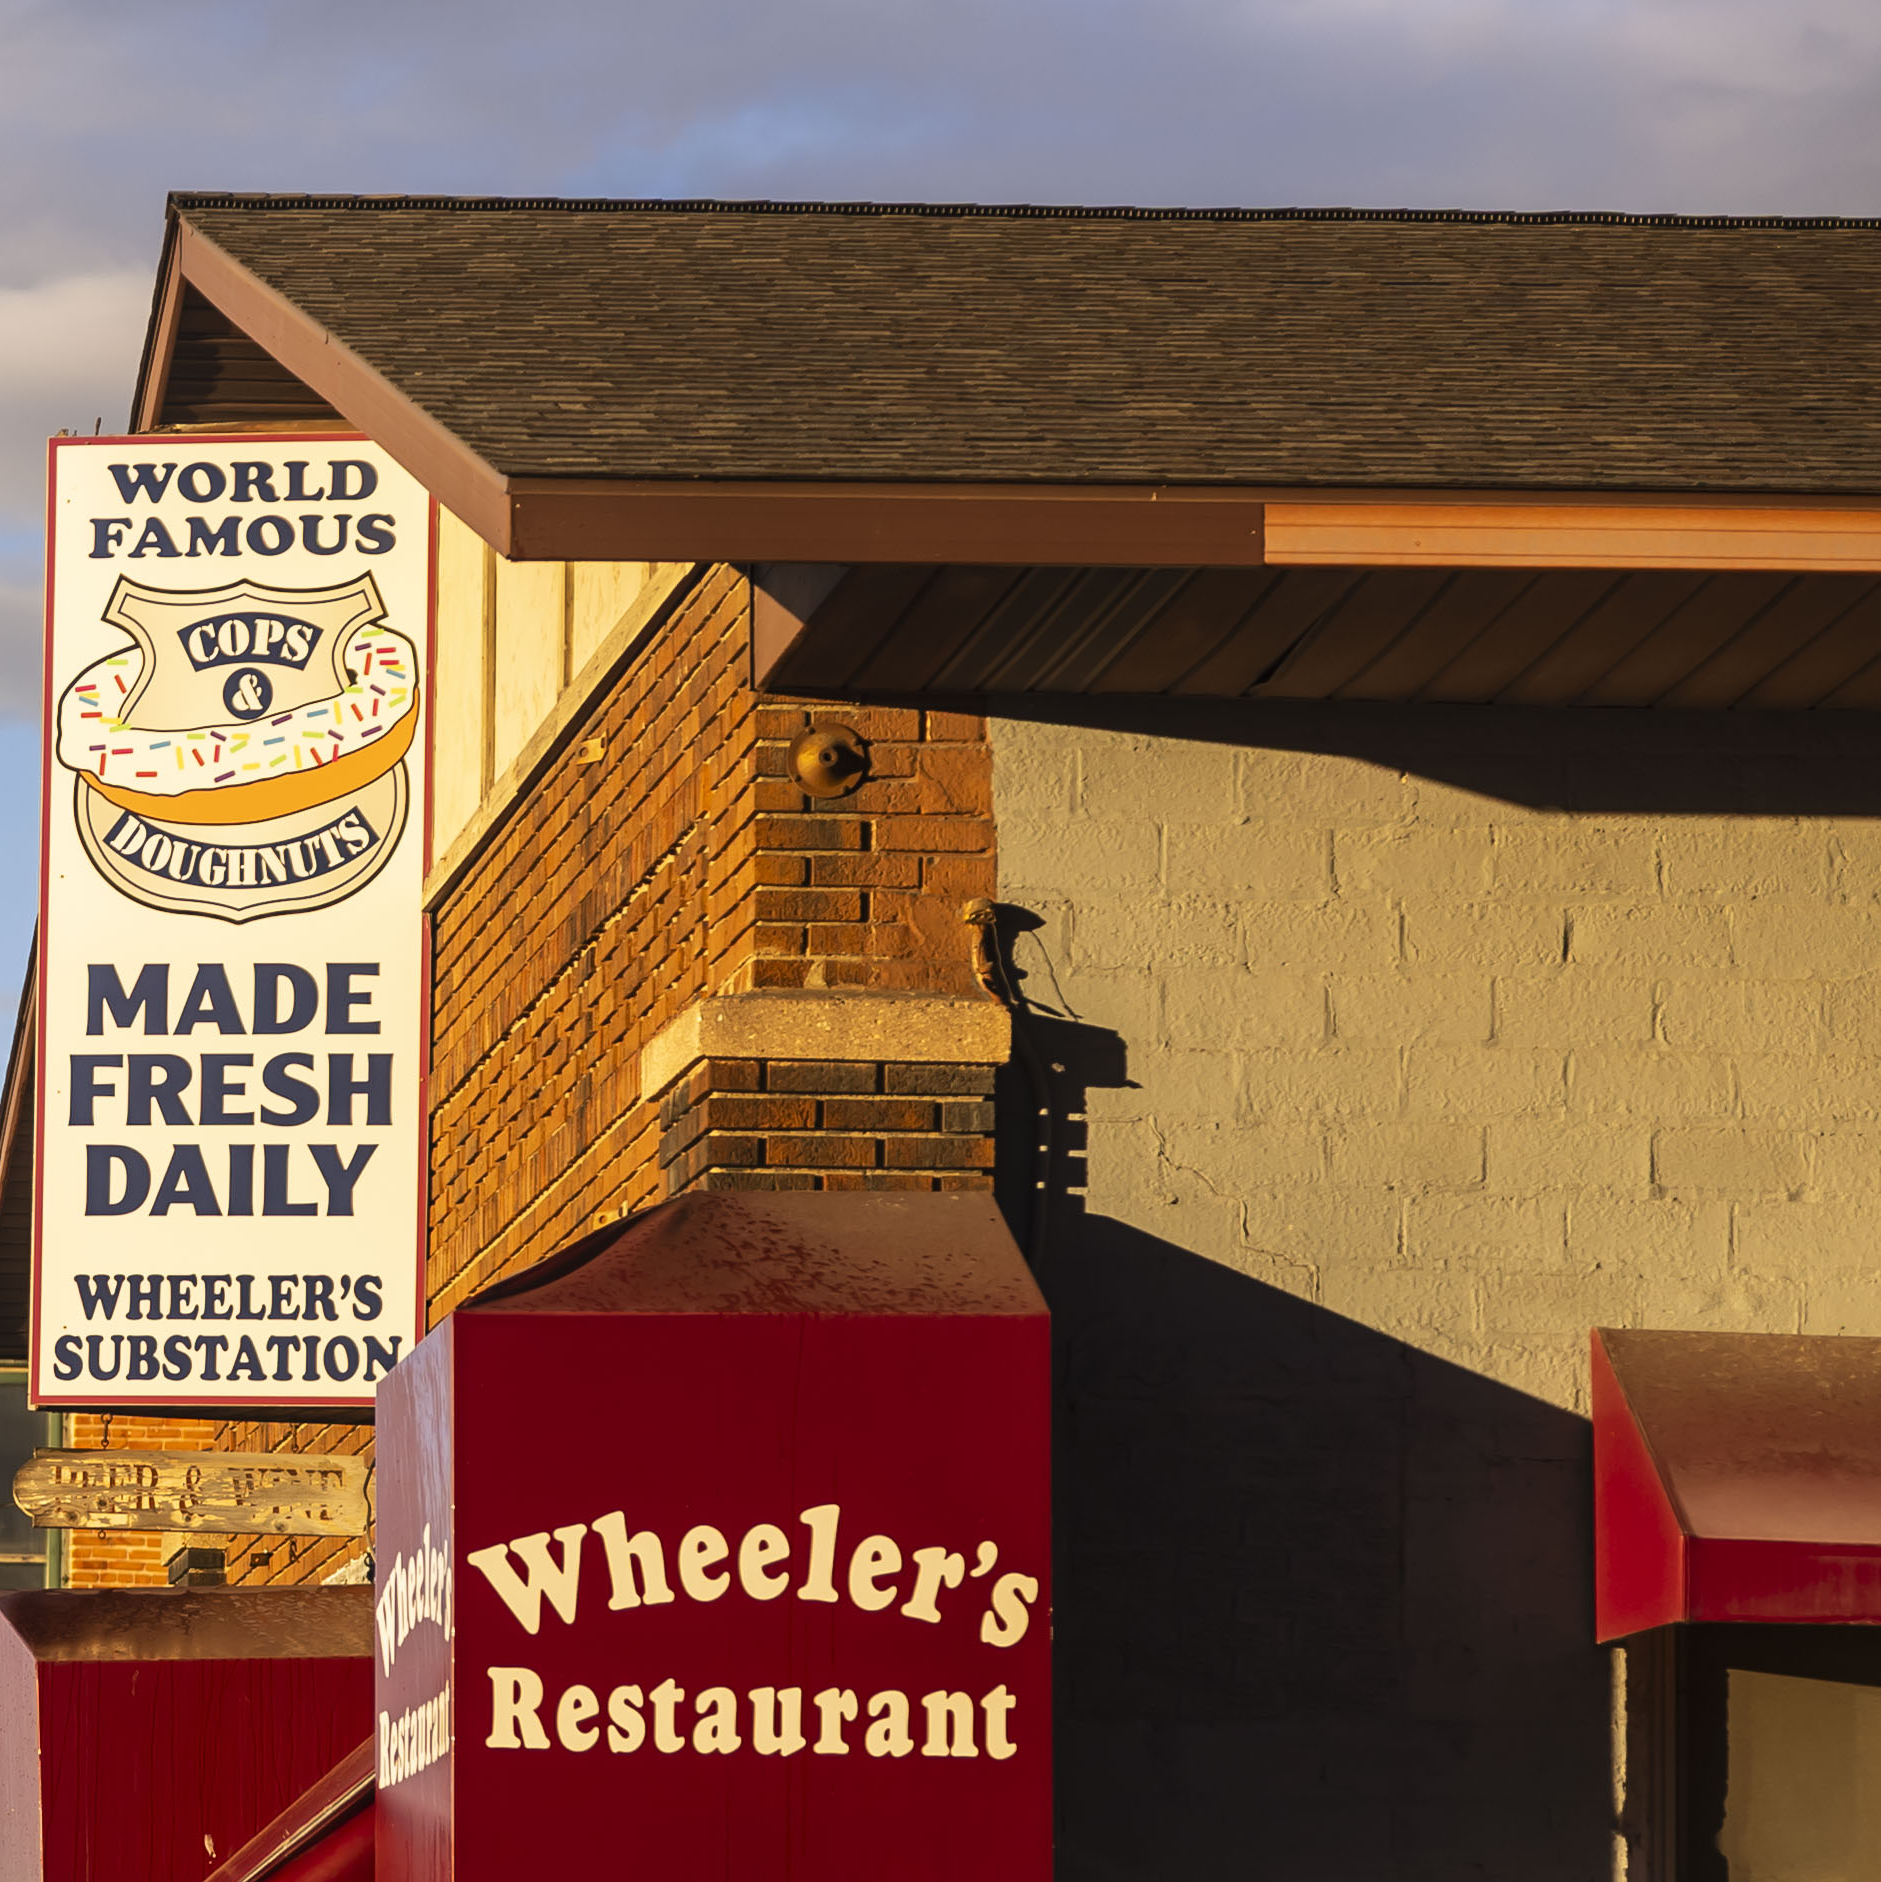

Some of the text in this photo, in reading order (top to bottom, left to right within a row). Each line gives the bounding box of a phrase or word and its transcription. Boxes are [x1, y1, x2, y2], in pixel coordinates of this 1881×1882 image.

[107, 459, 378, 504] WORLD
[88, 513, 397, 559] FAMOUS
[188, 618, 315, 663] COPS
[232, 673, 263, 712] &
[109, 813, 371, 886] DOUGHNUTS
[85, 962, 382, 1036] MADE
[68, 1052, 393, 1126] FRESH
[84, 1144, 379, 1217] DAILY
[73, 1274, 383, 1322] WHEELER'S
[53, 1334, 402, 1382] SUBSTATION
[376, 1522, 452, 1678] Wheeler's
[467, 1504, 1039, 1648] Wheeler's
[379, 1680, 450, 1790] Restaurant
[484, 1667, 1018, 1760] Restaurant
